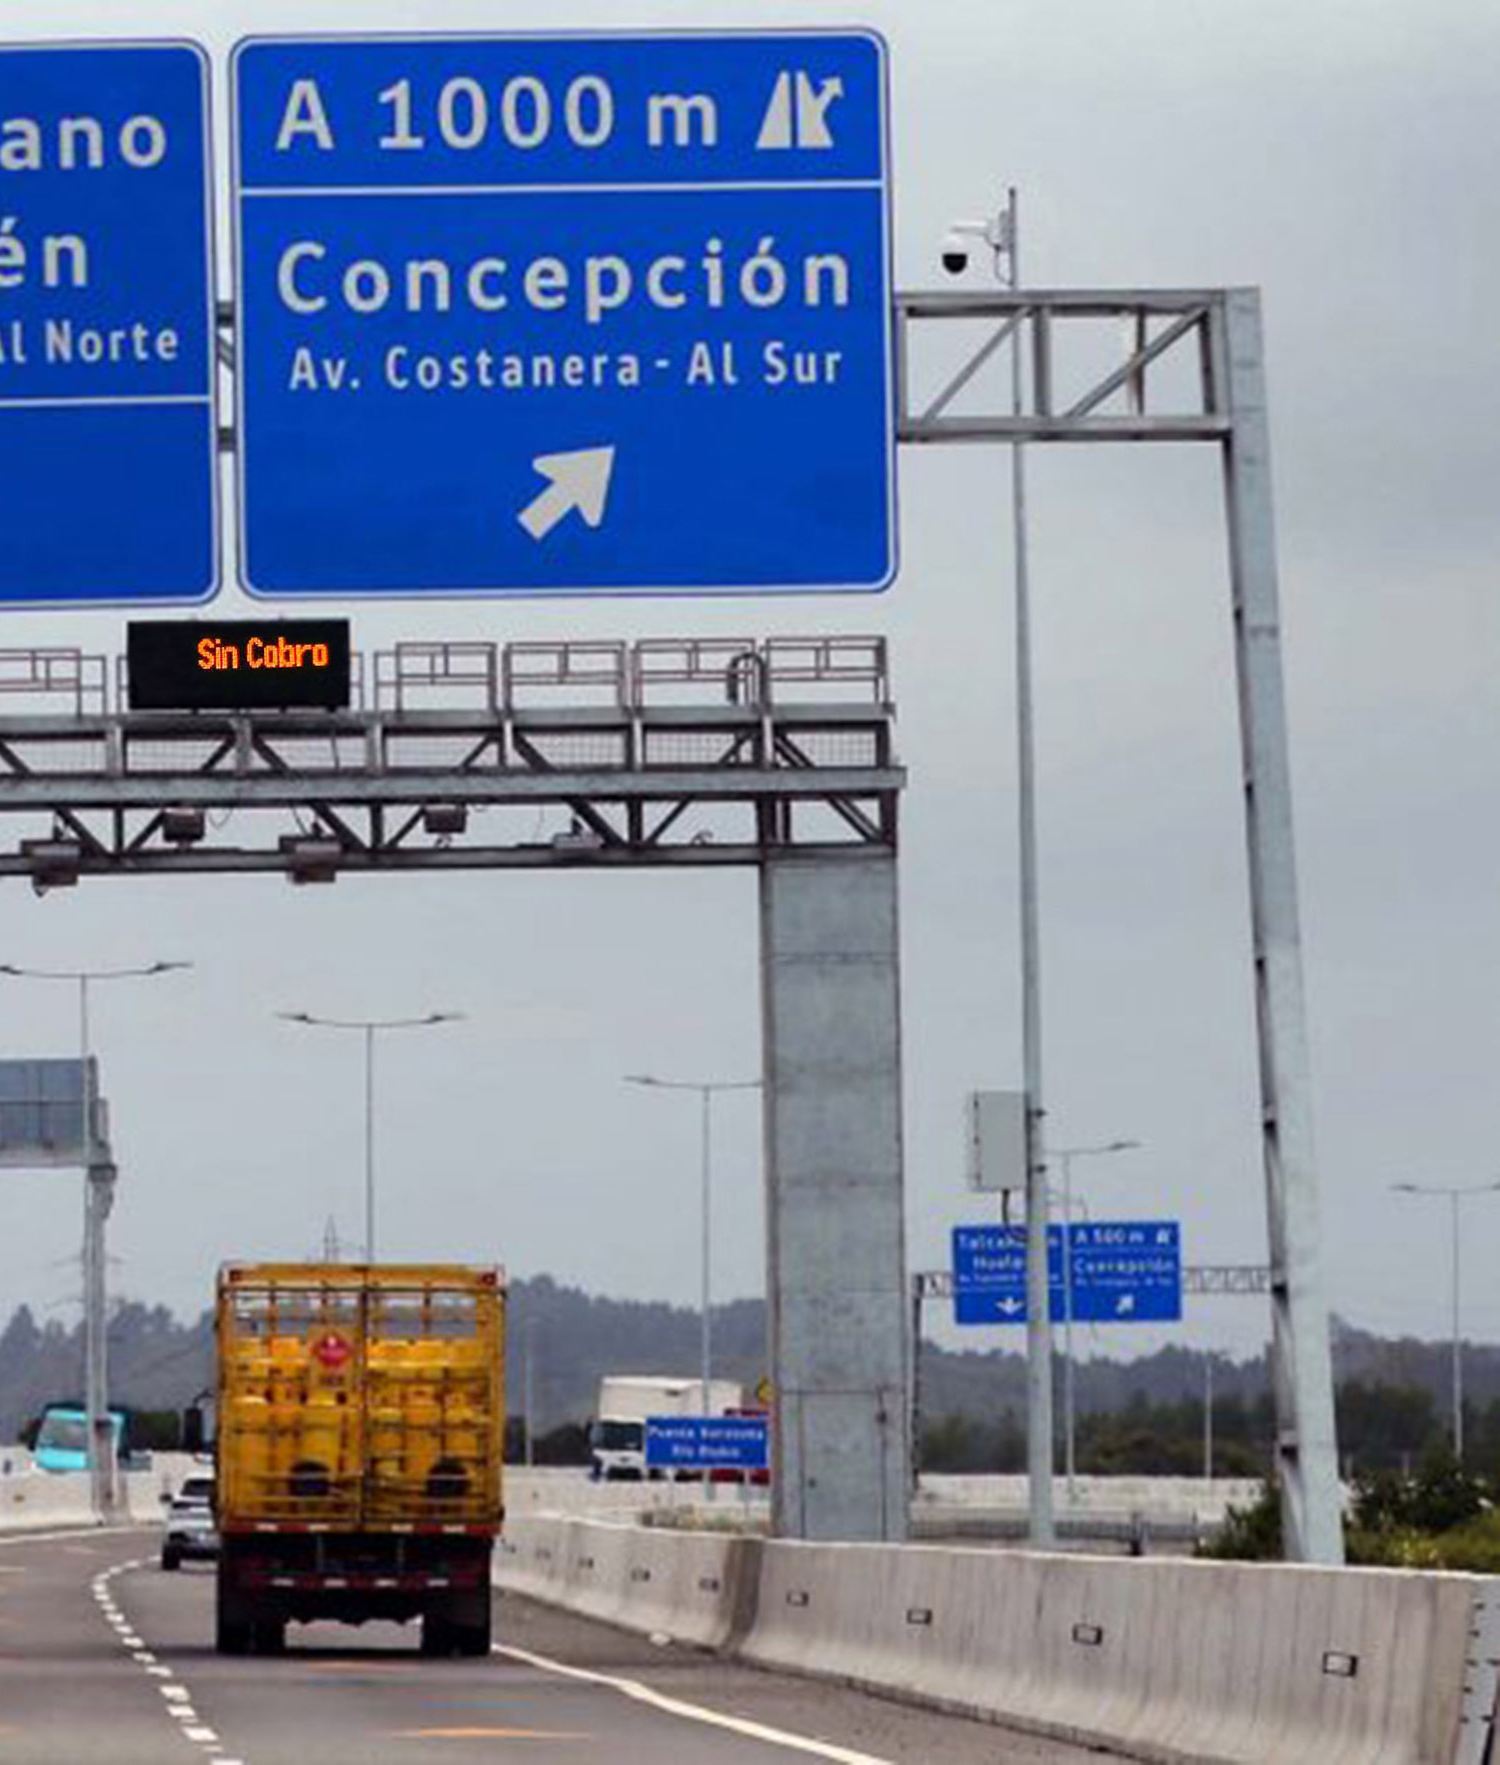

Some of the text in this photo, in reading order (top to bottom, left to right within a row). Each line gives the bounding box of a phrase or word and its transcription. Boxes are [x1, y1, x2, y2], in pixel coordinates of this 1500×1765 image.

[277, 76, 717, 149] A 1000 m
[277, 236, 849, 323] Concepción
[45, 320, 179, 361] Norte
[290, 348, 360, 389] Av.
[385, 346, 640, 389] Costanera
[687, 342, 737, 384] Al
[763, 341, 842, 384] Sur
[197, 636, 329, 671] Sin Cobro
